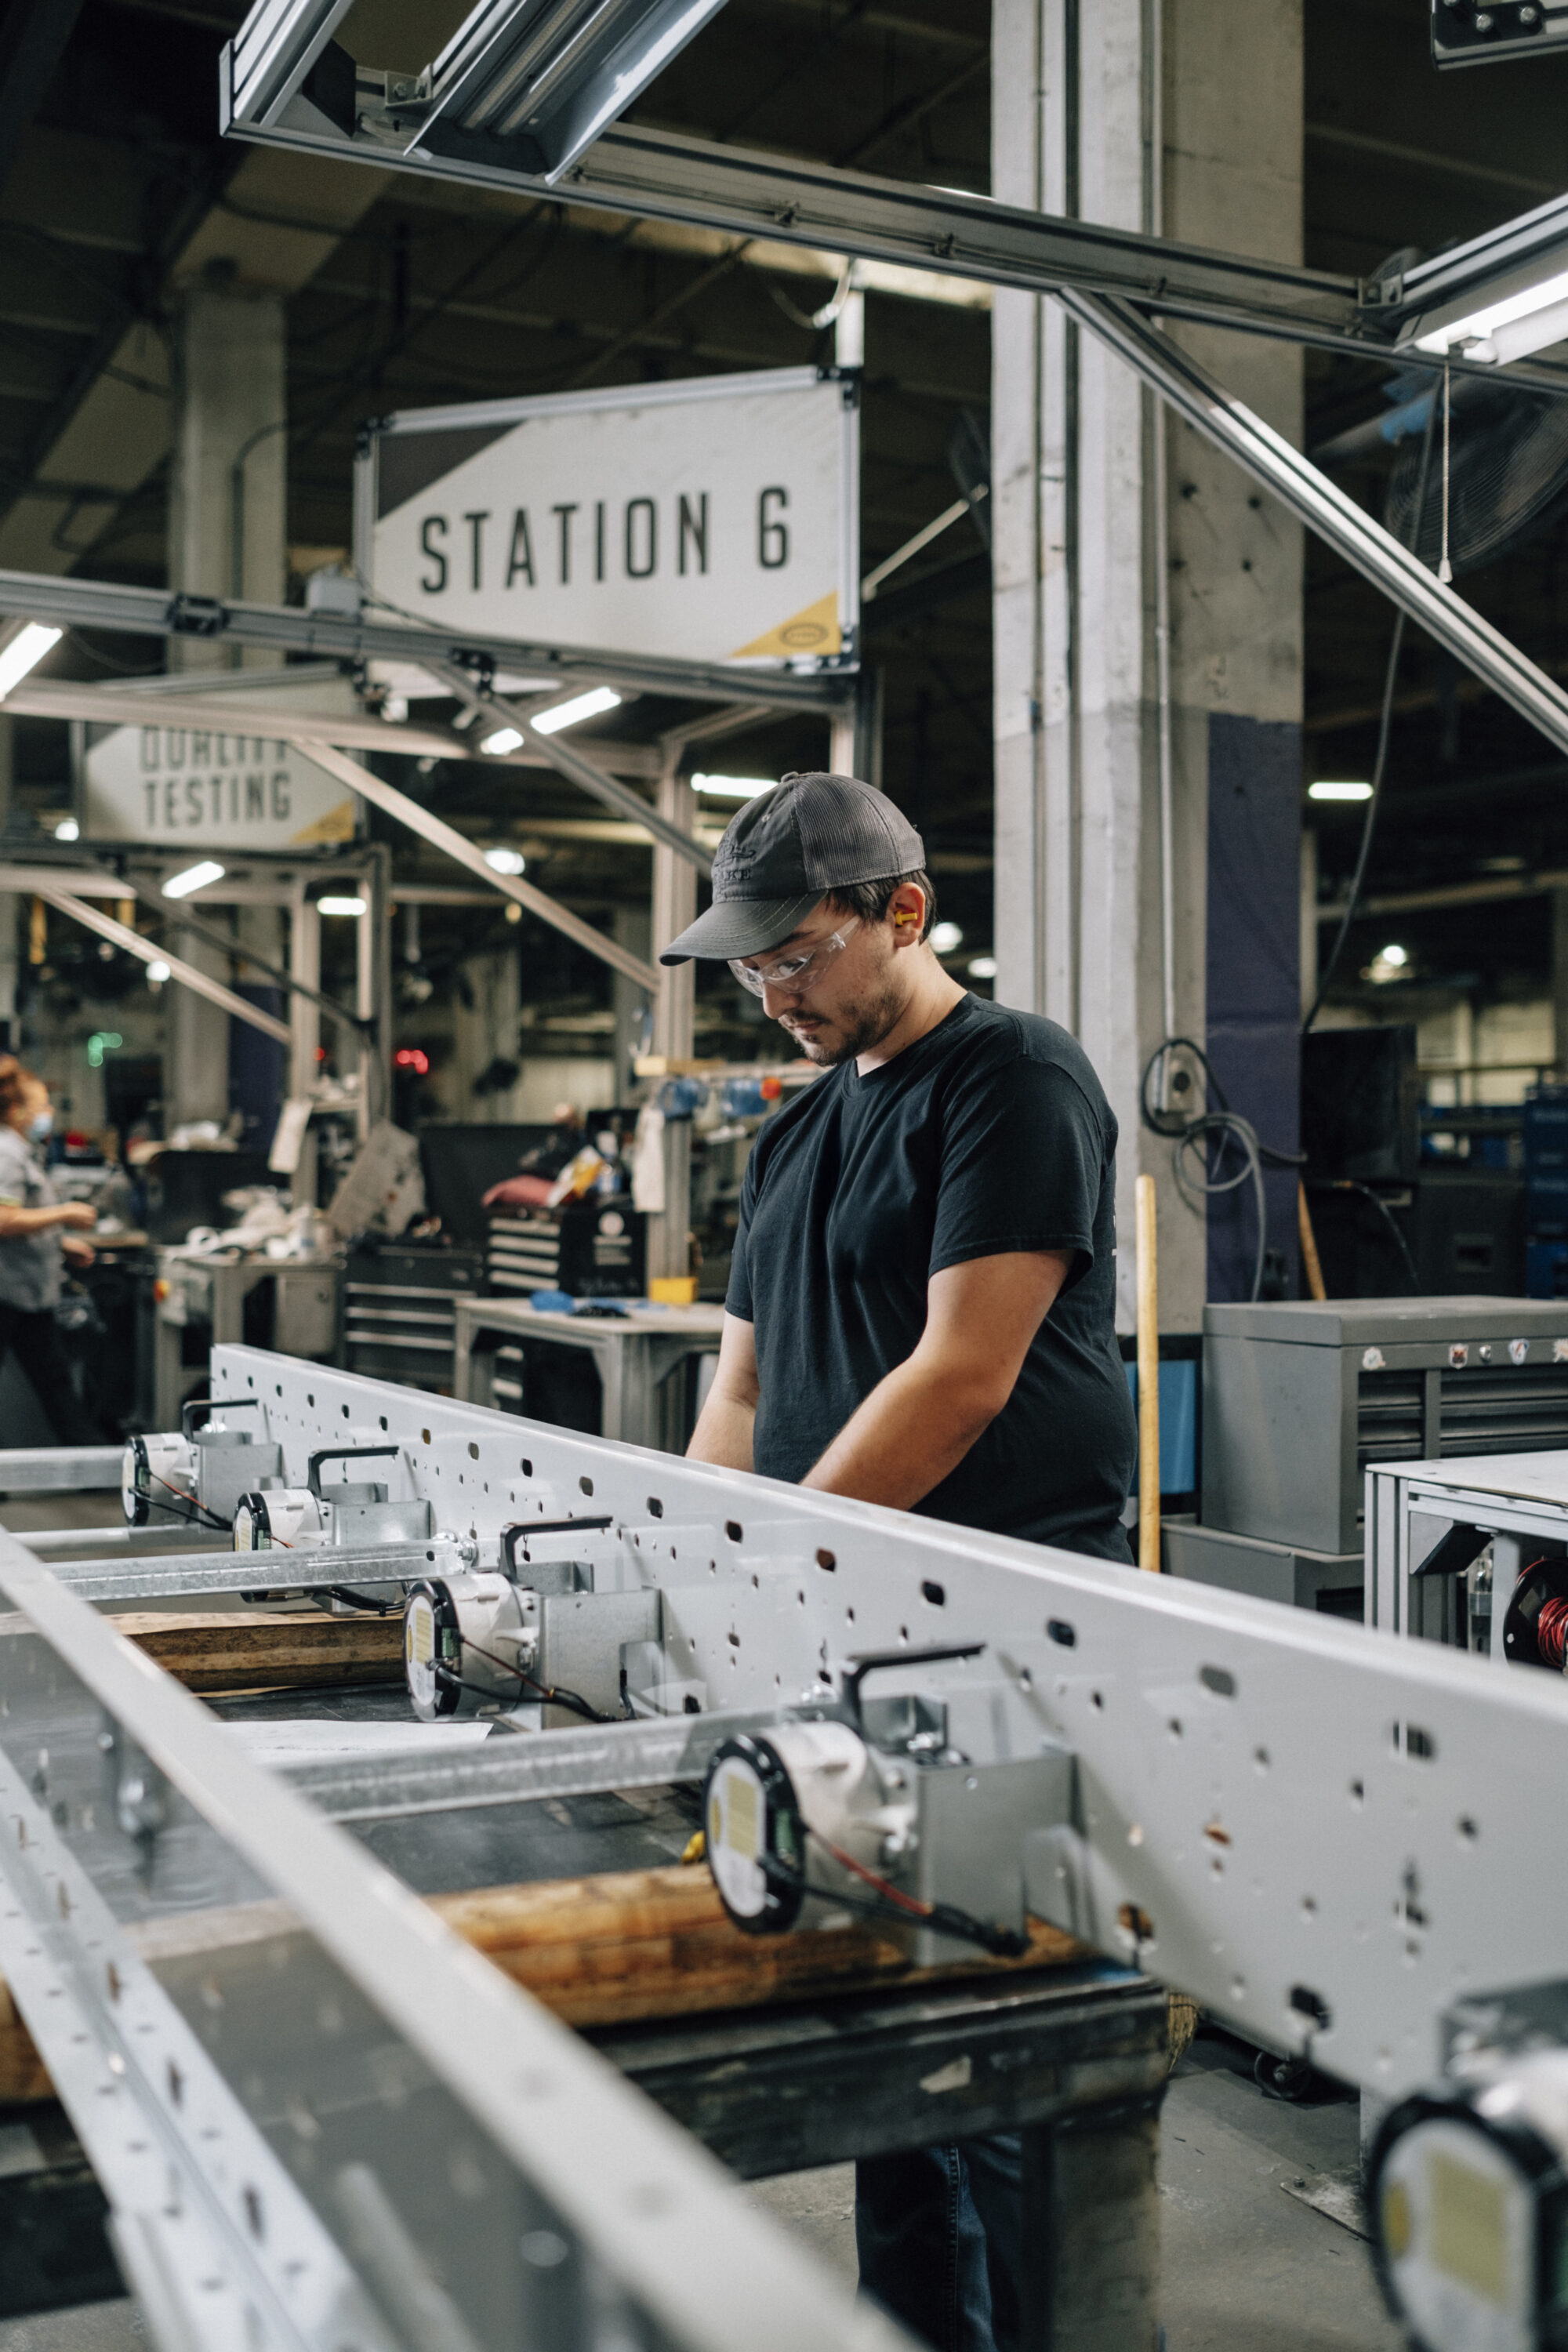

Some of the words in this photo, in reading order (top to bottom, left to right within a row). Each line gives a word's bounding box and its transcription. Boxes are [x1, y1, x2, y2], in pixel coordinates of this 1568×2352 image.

[419, 491, 710, 593] STATION
[759, 487, 789, 569] 6
[144, 771, 291, 828] TESTING
